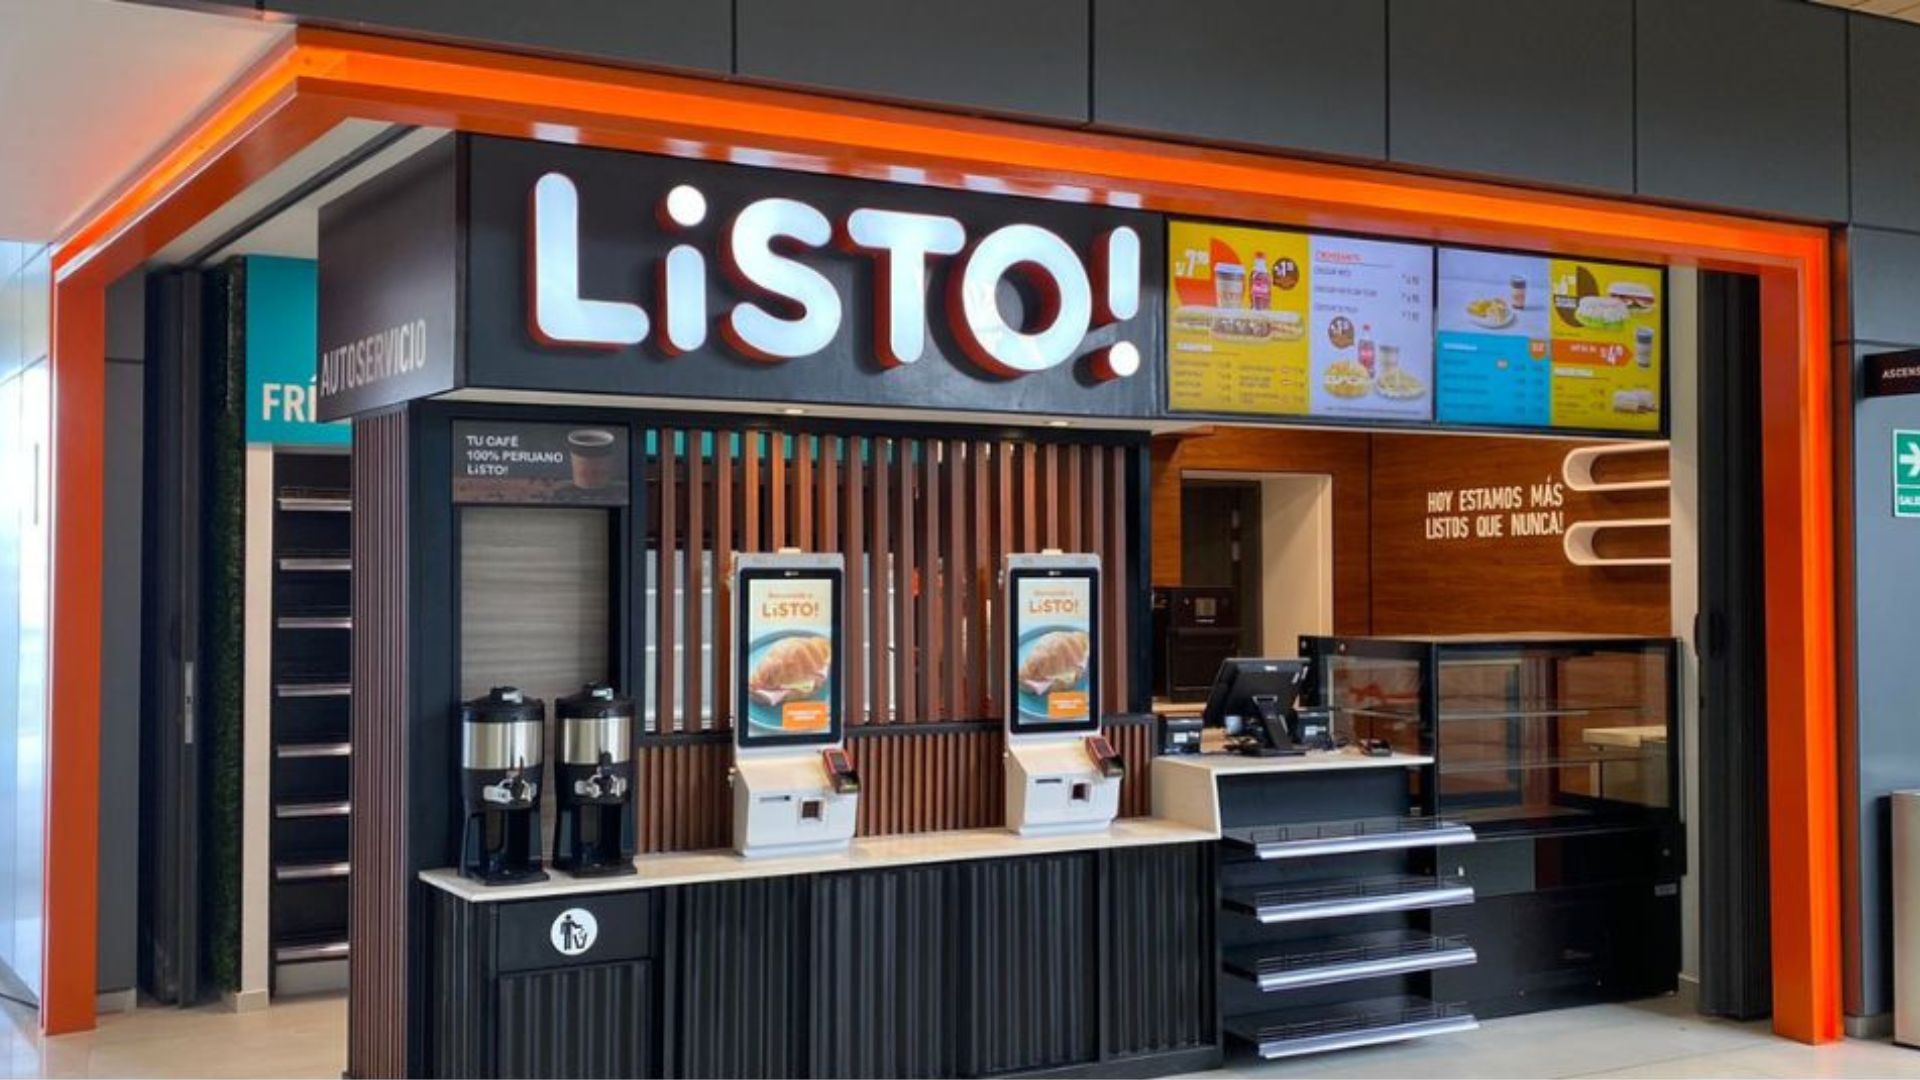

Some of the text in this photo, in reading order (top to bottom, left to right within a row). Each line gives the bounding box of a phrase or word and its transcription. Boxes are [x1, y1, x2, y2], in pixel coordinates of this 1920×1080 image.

[320, 319, 427, 397] AUTOSERVICIO
[466, 435, 484, 446] TU
[467, 450, 563, 463] 100% PERUANO
[1428, 475, 1563, 513] HOY ESTAMOS MÁS
[1426, 511, 1563, 539] LISTOS QUE NUNCA!
